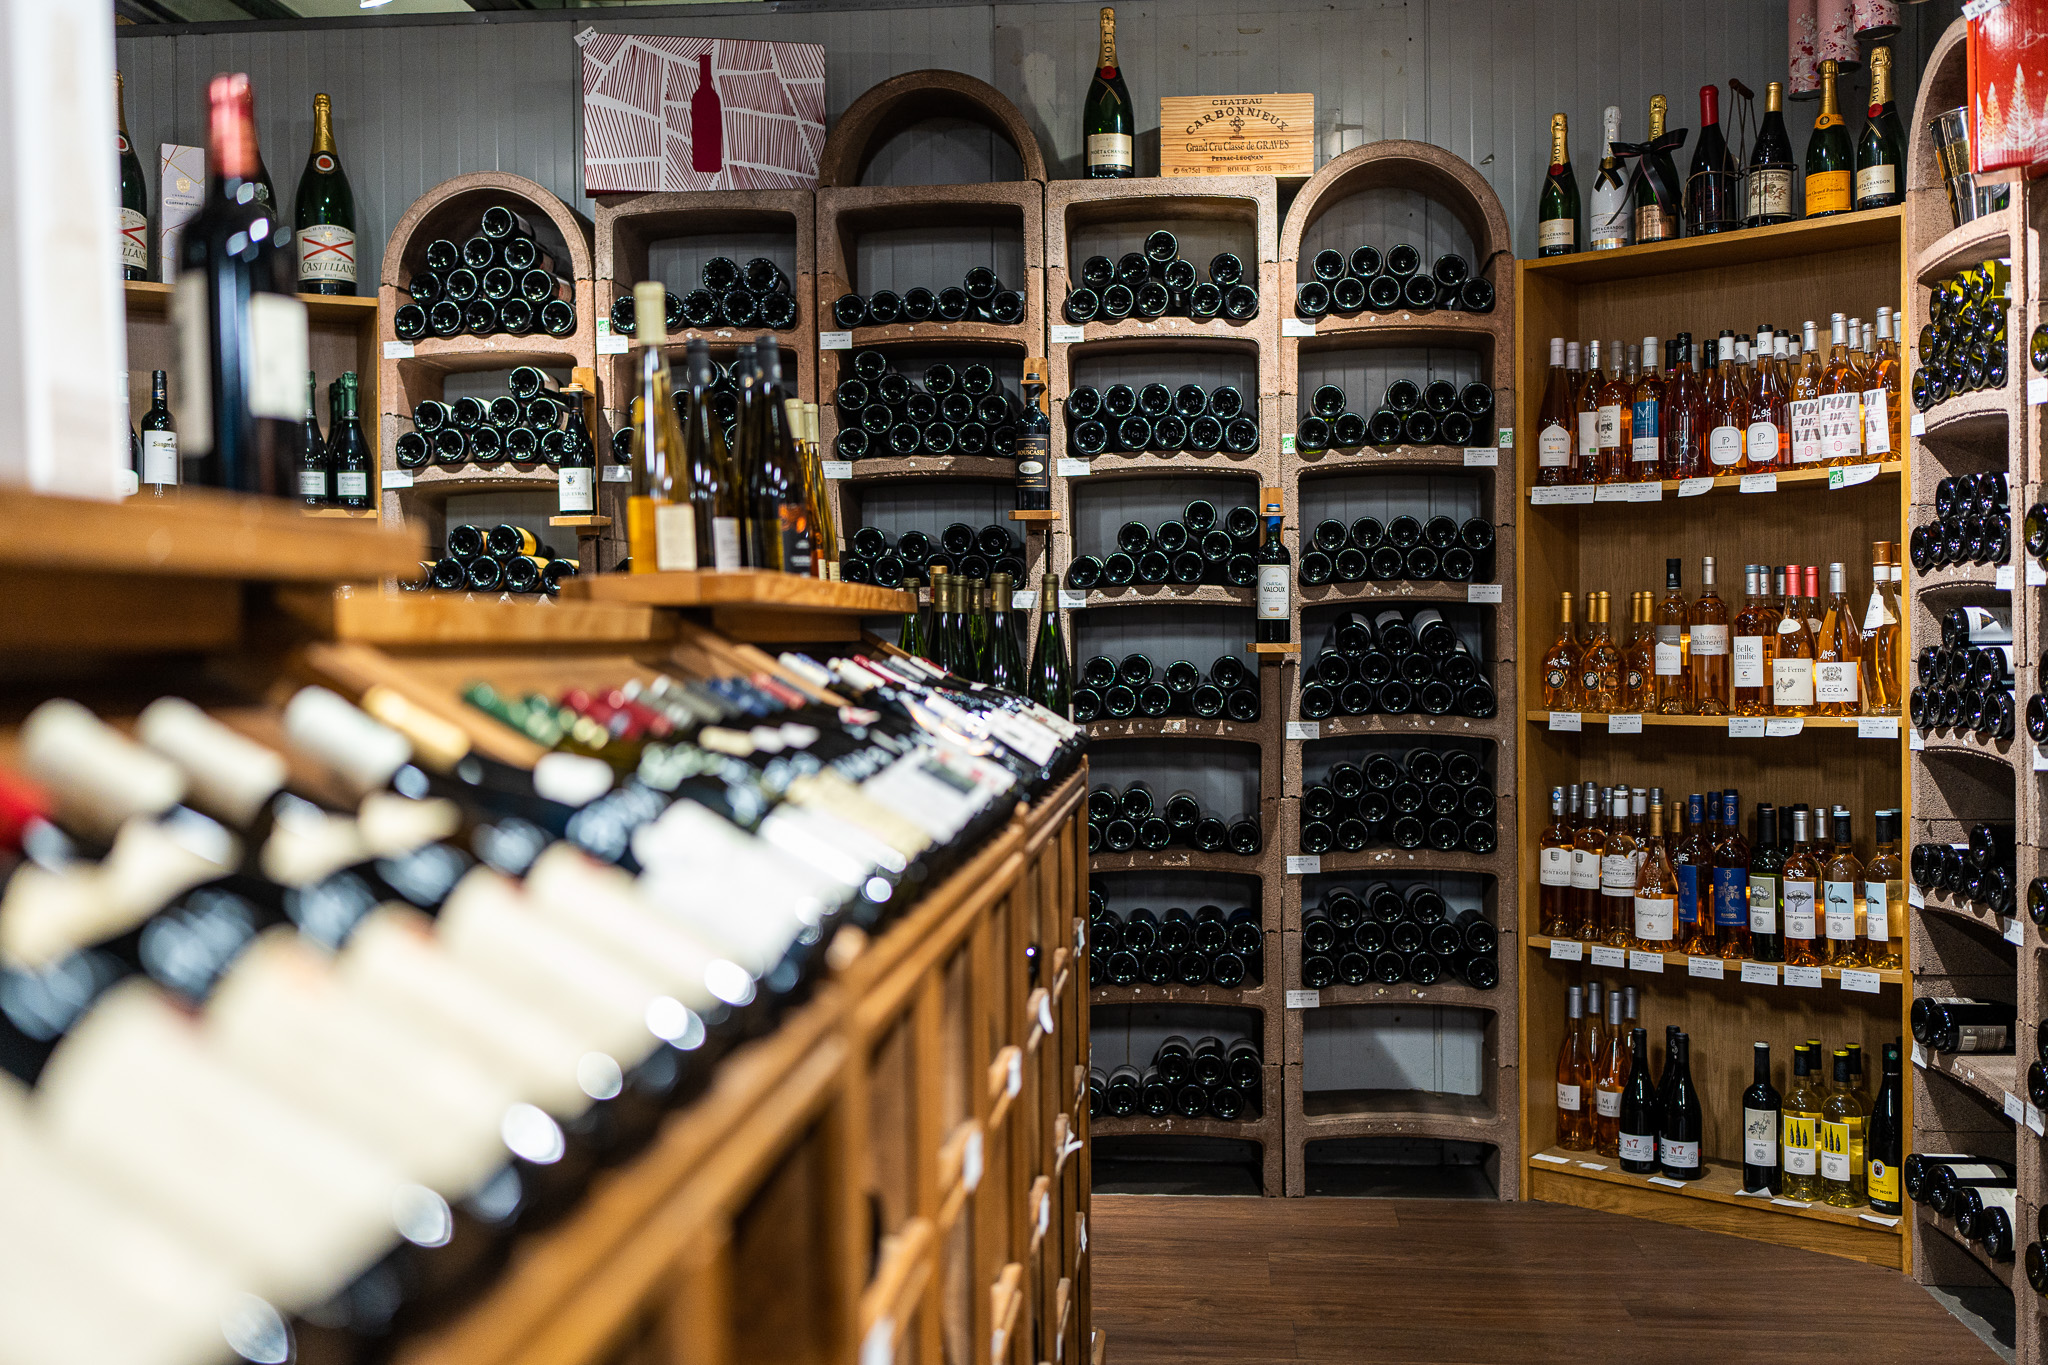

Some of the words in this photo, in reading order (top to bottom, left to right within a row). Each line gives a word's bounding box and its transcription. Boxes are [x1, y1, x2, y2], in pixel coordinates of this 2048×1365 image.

[1212, 98, 1262, 106] CHATEAU
[1186, 107, 1288, 135] CARBONNIEUX
[1186, 142, 1208, 152] Grand
[1208, 142, 1222, 151] Cru
[1223, 141, 1245, 151] Classé
[1246, 141, 1255, 150] de
[1256, 140, 1289, 150] GRAVES
[1867, 179, 1891, 187] CHANDON
[302, 262, 356, 275] CASTELLANE
[1822, 395, 1856, 411] POT
[1830, 411, 1846, 420] DE
[1801, 417, 1816, 426] DE
[1824, 423, 1852, 437] VIN
[1736, 644, 1754, 653] Belle
